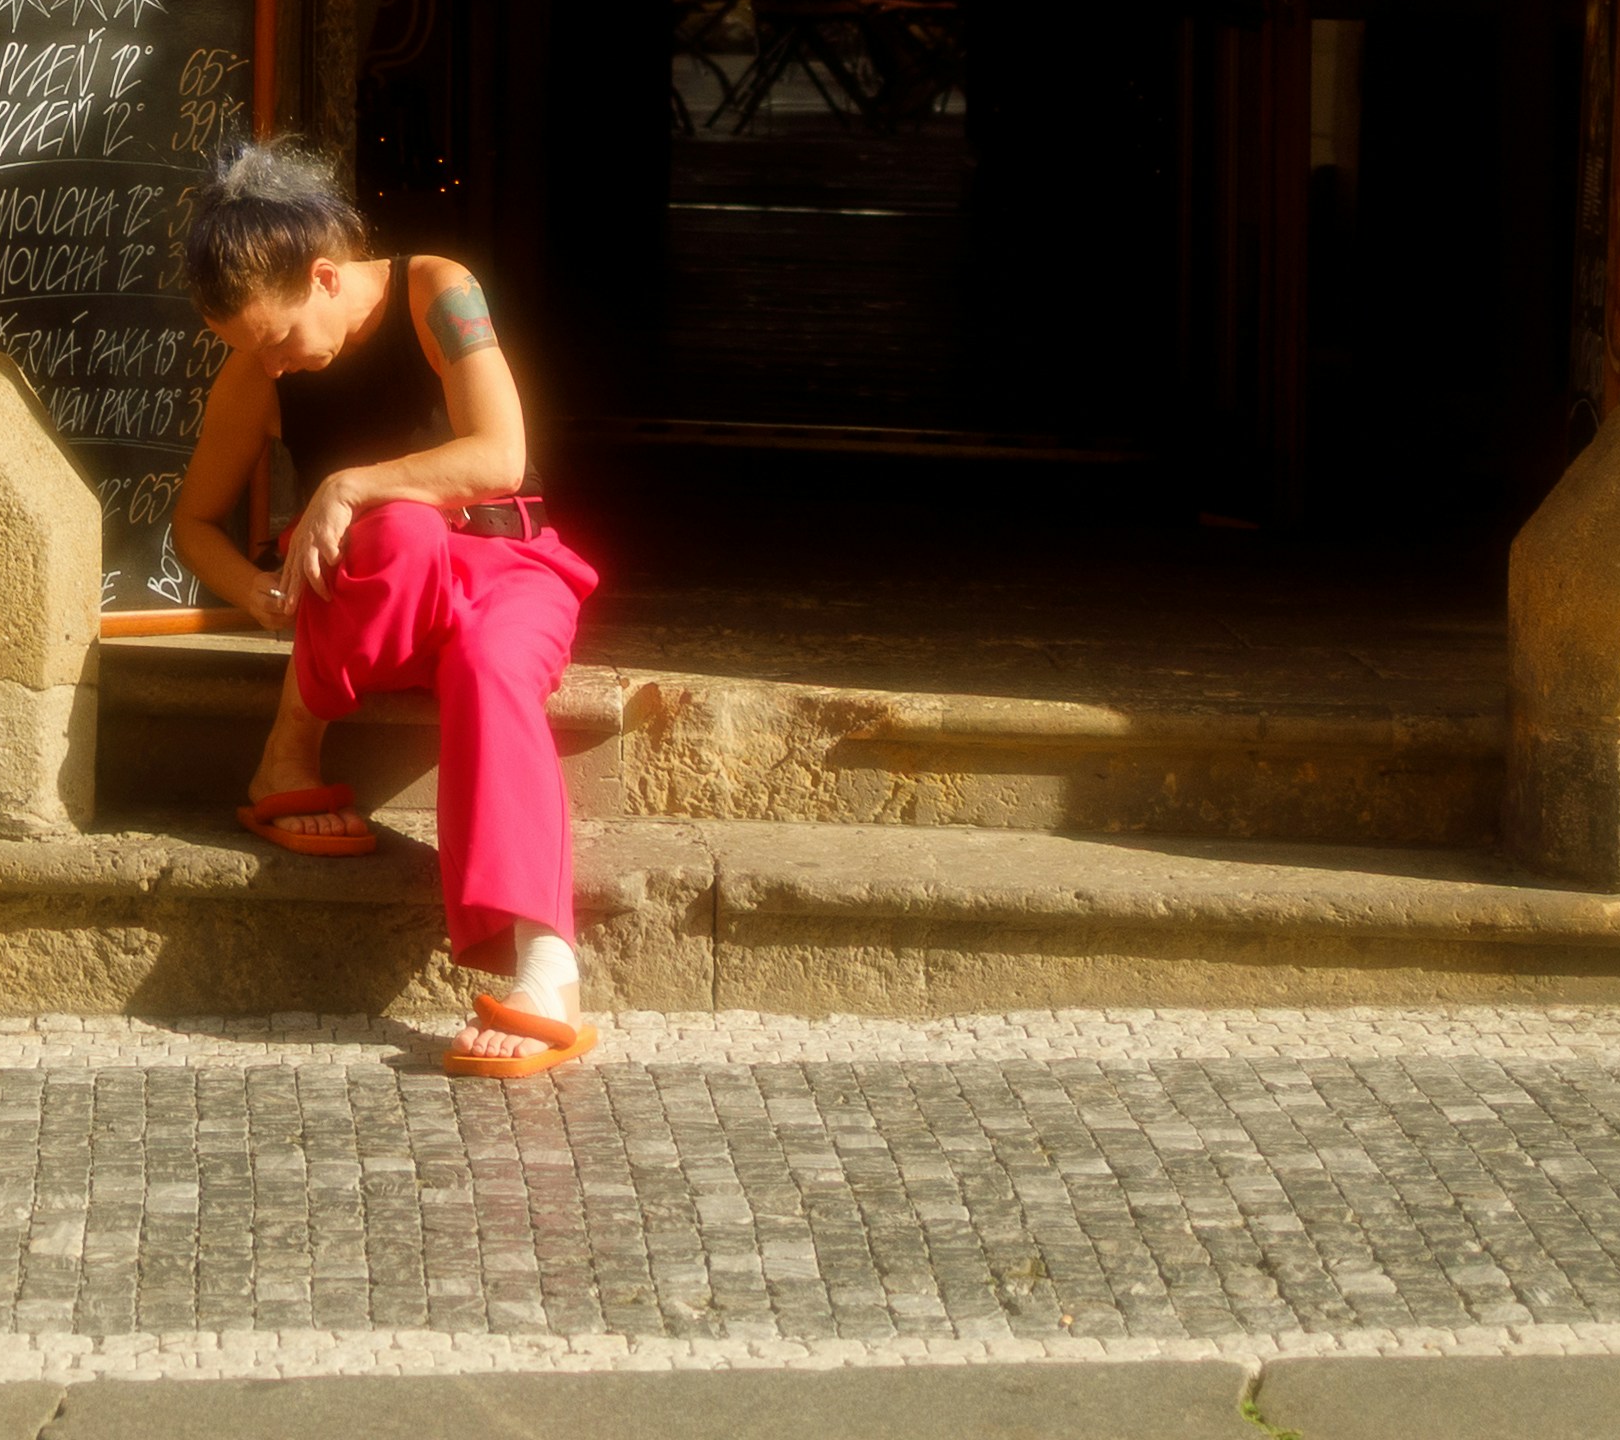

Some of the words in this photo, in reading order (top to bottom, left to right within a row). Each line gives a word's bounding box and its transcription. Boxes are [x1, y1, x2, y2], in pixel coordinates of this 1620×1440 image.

[110, 43, 153, 99] 12°
[103, 102, 145, 156] 12°
[122, 184, 164, 238] 12°
[118, 243, 155, 292] 12°
[87, 327, 153, 377] PAKA
[95, 386, 151, 437] PAKA
